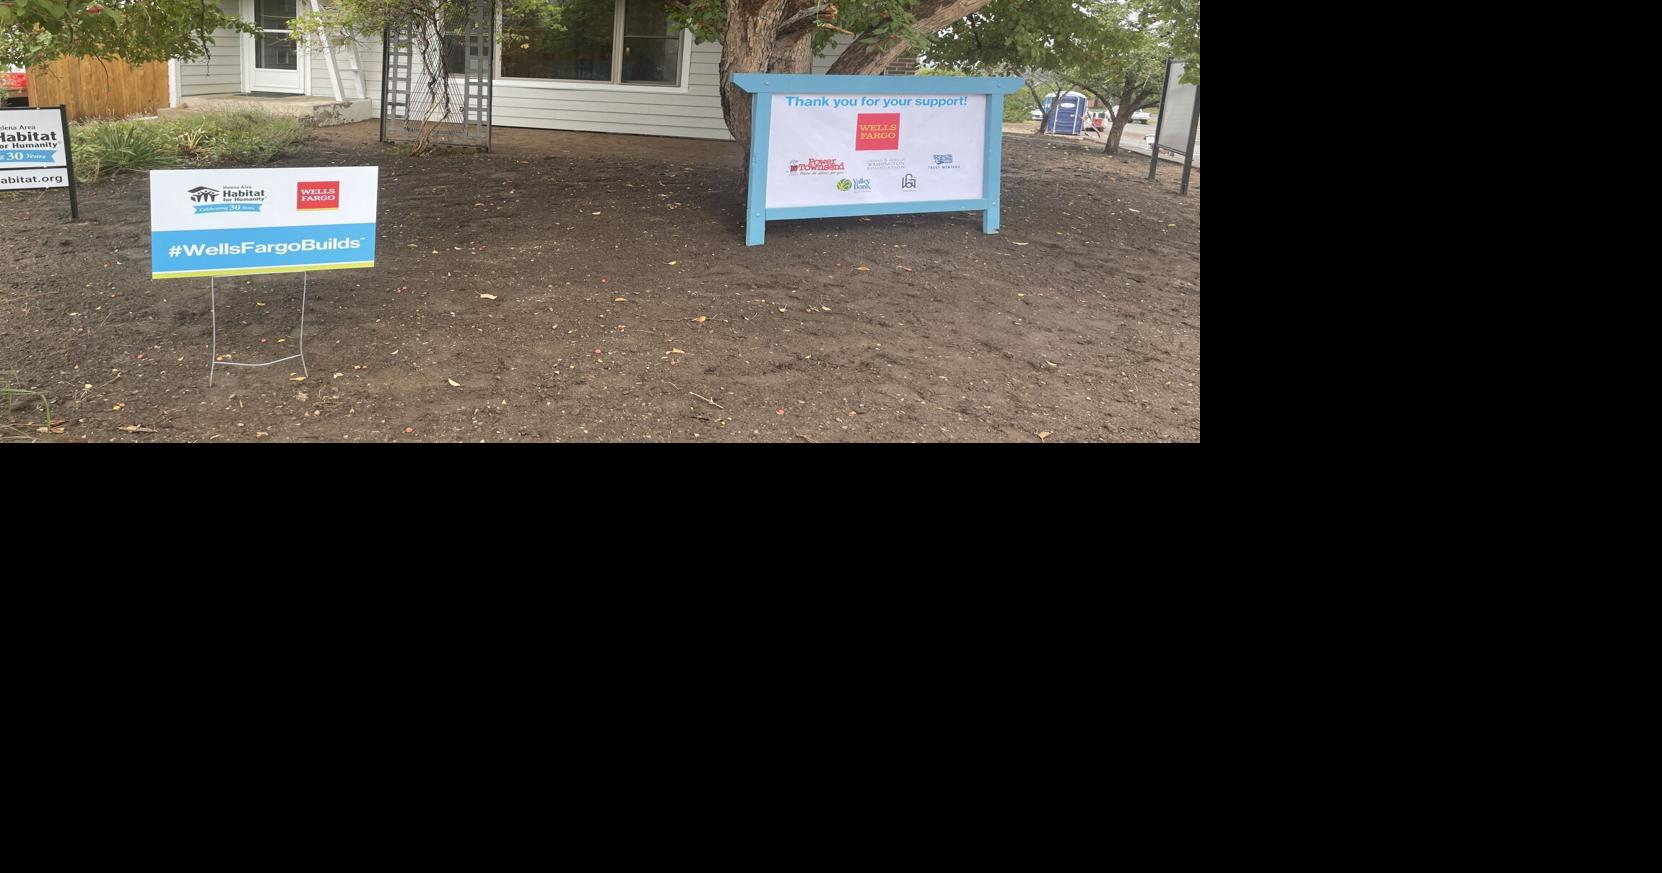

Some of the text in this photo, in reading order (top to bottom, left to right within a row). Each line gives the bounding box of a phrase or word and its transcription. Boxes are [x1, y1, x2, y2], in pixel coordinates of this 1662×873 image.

[785, 96, 968, 108] Thank you for your support!
[859, 124, 897, 132] WELLS
[860, 132, 896, 140] FARGO
[6, 152, 23, 160] 30
[799, 162, 845, 171] Townsend
[223, 190, 265, 198] Habitat
[301, 194, 336, 202] FARGO
[168, 237, 361, 257] #WellsFargoBuilds
